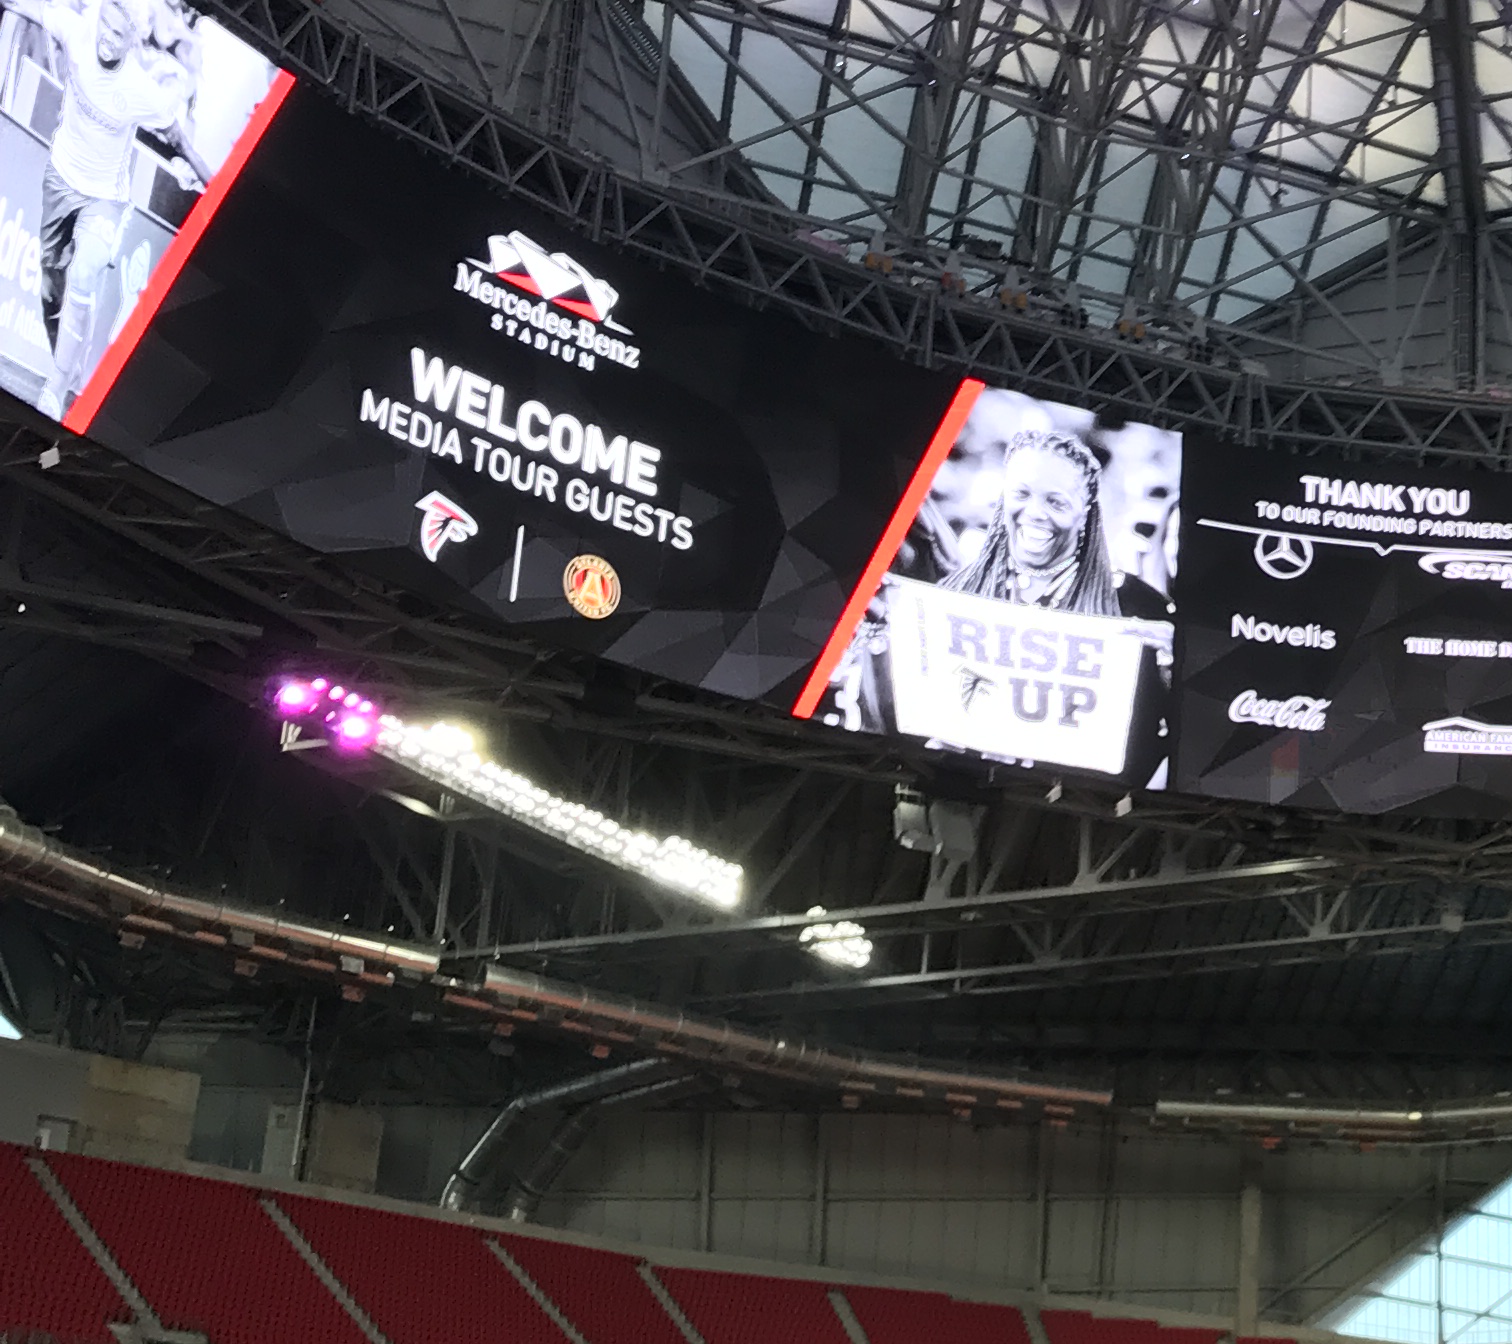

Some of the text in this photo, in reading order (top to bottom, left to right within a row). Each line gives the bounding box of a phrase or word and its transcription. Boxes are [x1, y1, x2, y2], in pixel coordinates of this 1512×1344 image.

[453, 262, 641, 369] Mercedes-Benz
[490, 313, 596, 371] STADIUM
[410, 346, 662, 497] WELCOME
[360, 388, 694, 551] MEDIA TOUR GUESTS
[1255, 500, 1280, 520] TO
[1281, 505, 1321, 525] OUR
[1322, 509, 1417, 536] FOUNDING
[1300, 475, 1471, 516] THANK YOU
[946, 613, 1105, 680] RISE
[1231, 613, 1336, 650] Novelis
[1403, 636, 1443, 655] THE
[1445, 639, 1498, 658] HOME
[1009, 677, 1098, 728] UP
[1425, 729, 1488, 744] AMERICAN
